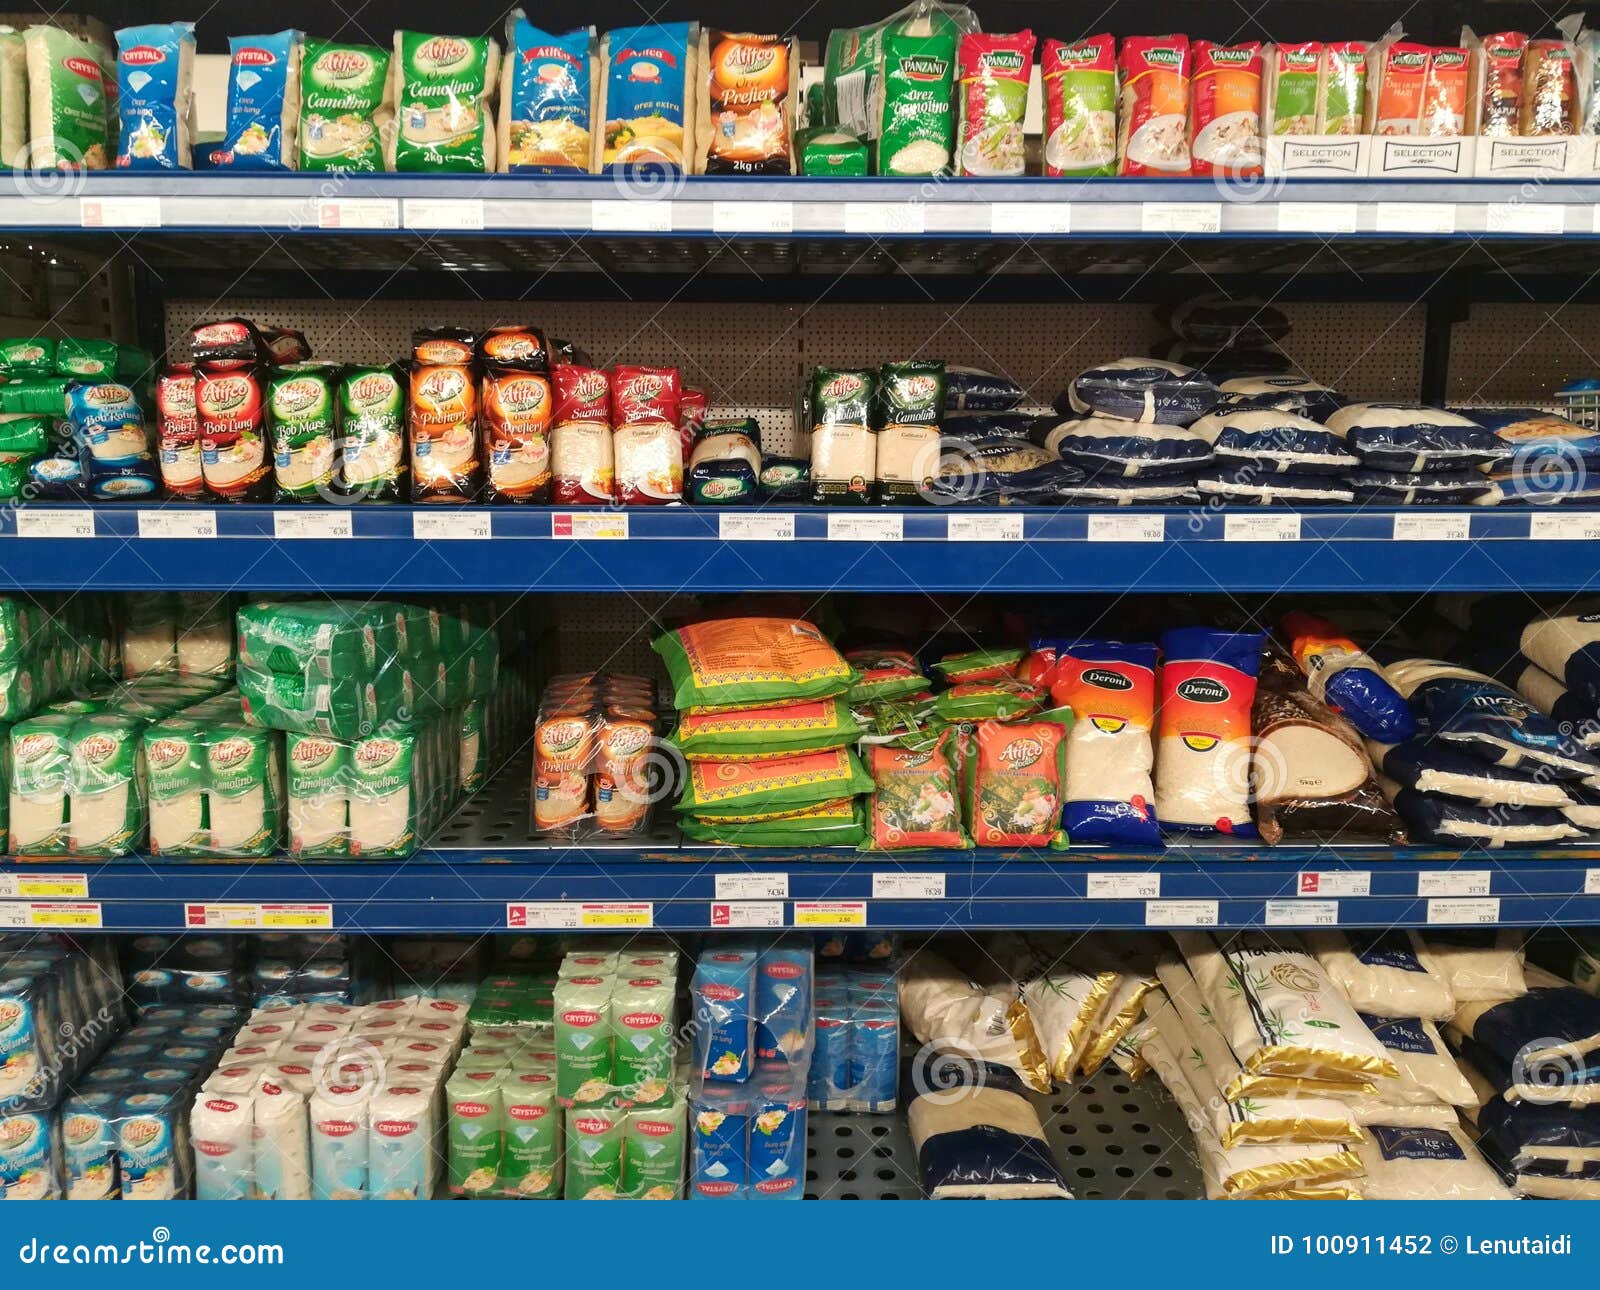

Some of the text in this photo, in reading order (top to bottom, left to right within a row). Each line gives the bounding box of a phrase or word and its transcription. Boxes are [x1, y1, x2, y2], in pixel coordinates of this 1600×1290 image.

[415, 36, 469, 59] Atifco
[125, 51, 159, 62] CRYSTAL
[236, 51, 270, 63] CRYSTAL
[980, 55, 1026, 67] PANZANI
[1060, 50, 1098, 61] PANZANI
[1147, 51, 1182, 63] PANZANI
[1213, 50, 1251, 60] PANZANI
[316, 52, 369, 72] Atifco
[904, 60, 944, 74] PANZANI
[69, 60, 101, 78] CRYSTA
[408, 80, 474, 98] Camolino
[307, 93, 371, 110] Camolino
[1292, 149, 1351, 158] SELECTION
[1393, 150, 1453, 158] SELECTION
[1501, 149, 1560, 157] SELECTION
[733, 161, 753, 171] 2kg
[202, 381, 249, 403] Atifco
[351, 381, 394, 400] Atifco
[895, 409, 937, 424] Camolino
[203, 421, 226, 435] Bob
[228, 419, 253, 434] Lung
[276, 425, 297, 438] Bob
[1089, 672, 1127, 687] Deroni
[1184, 684, 1224, 698] Deroni
[292, 739, 335, 761] Atifco
[998, 739, 1043, 761] Atifco
[565, 1014, 597, 1023] CRYSTAL
[624, 1016, 659, 1025] CRYSTAL
[455, 1104, 488, 1114] CRYSTAL
[511, 1107, 544, 1117] CRYSTAL
[320, 1123, 354, 1132] CRYSTAL
[378, 1123, 412, 1132] CRYSTAL
[638, 1123, 671, 1133] CRYSTAL
